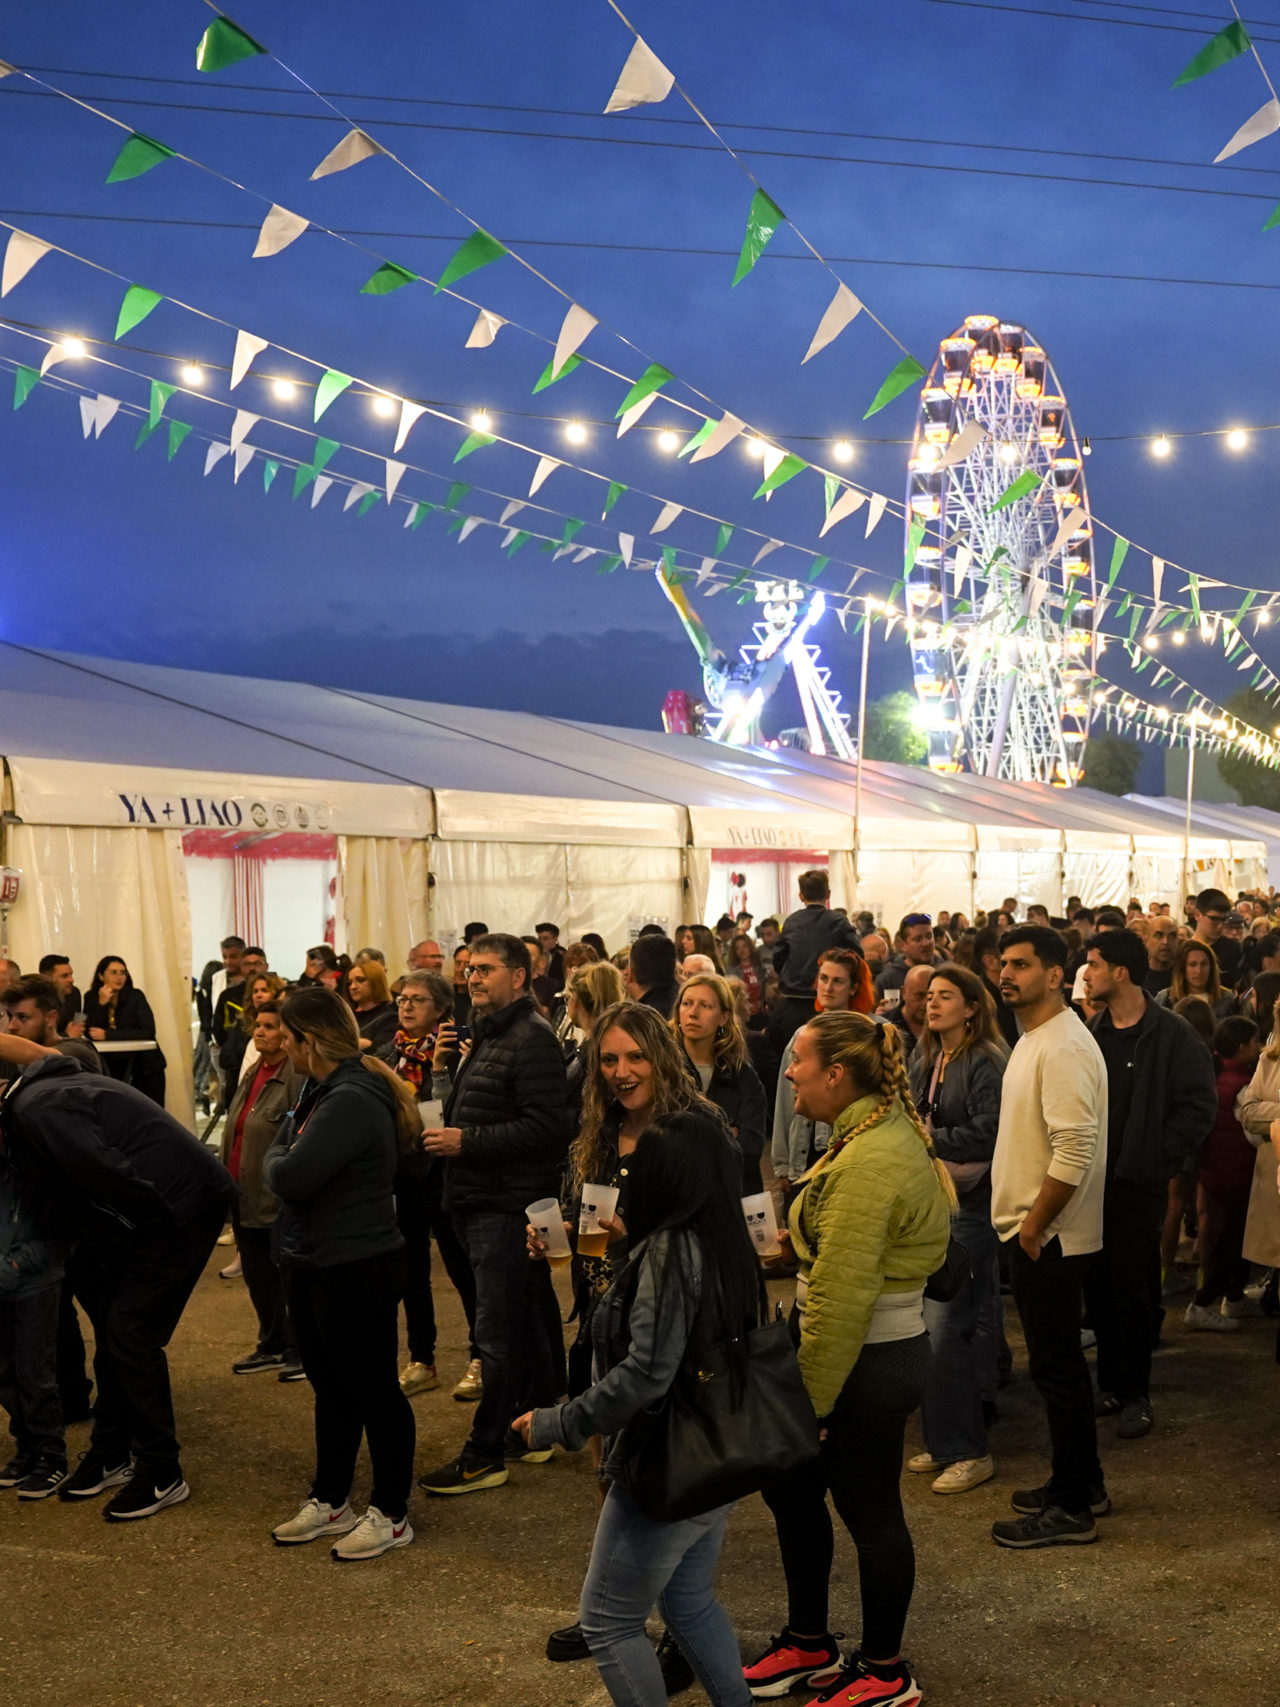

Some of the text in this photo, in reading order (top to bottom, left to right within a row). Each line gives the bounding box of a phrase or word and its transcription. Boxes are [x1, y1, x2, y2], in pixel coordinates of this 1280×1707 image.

[118, 793, 157, 824] YA
[161, 802, 175, 822] +
[180, 797, 243, 828] LIAO
